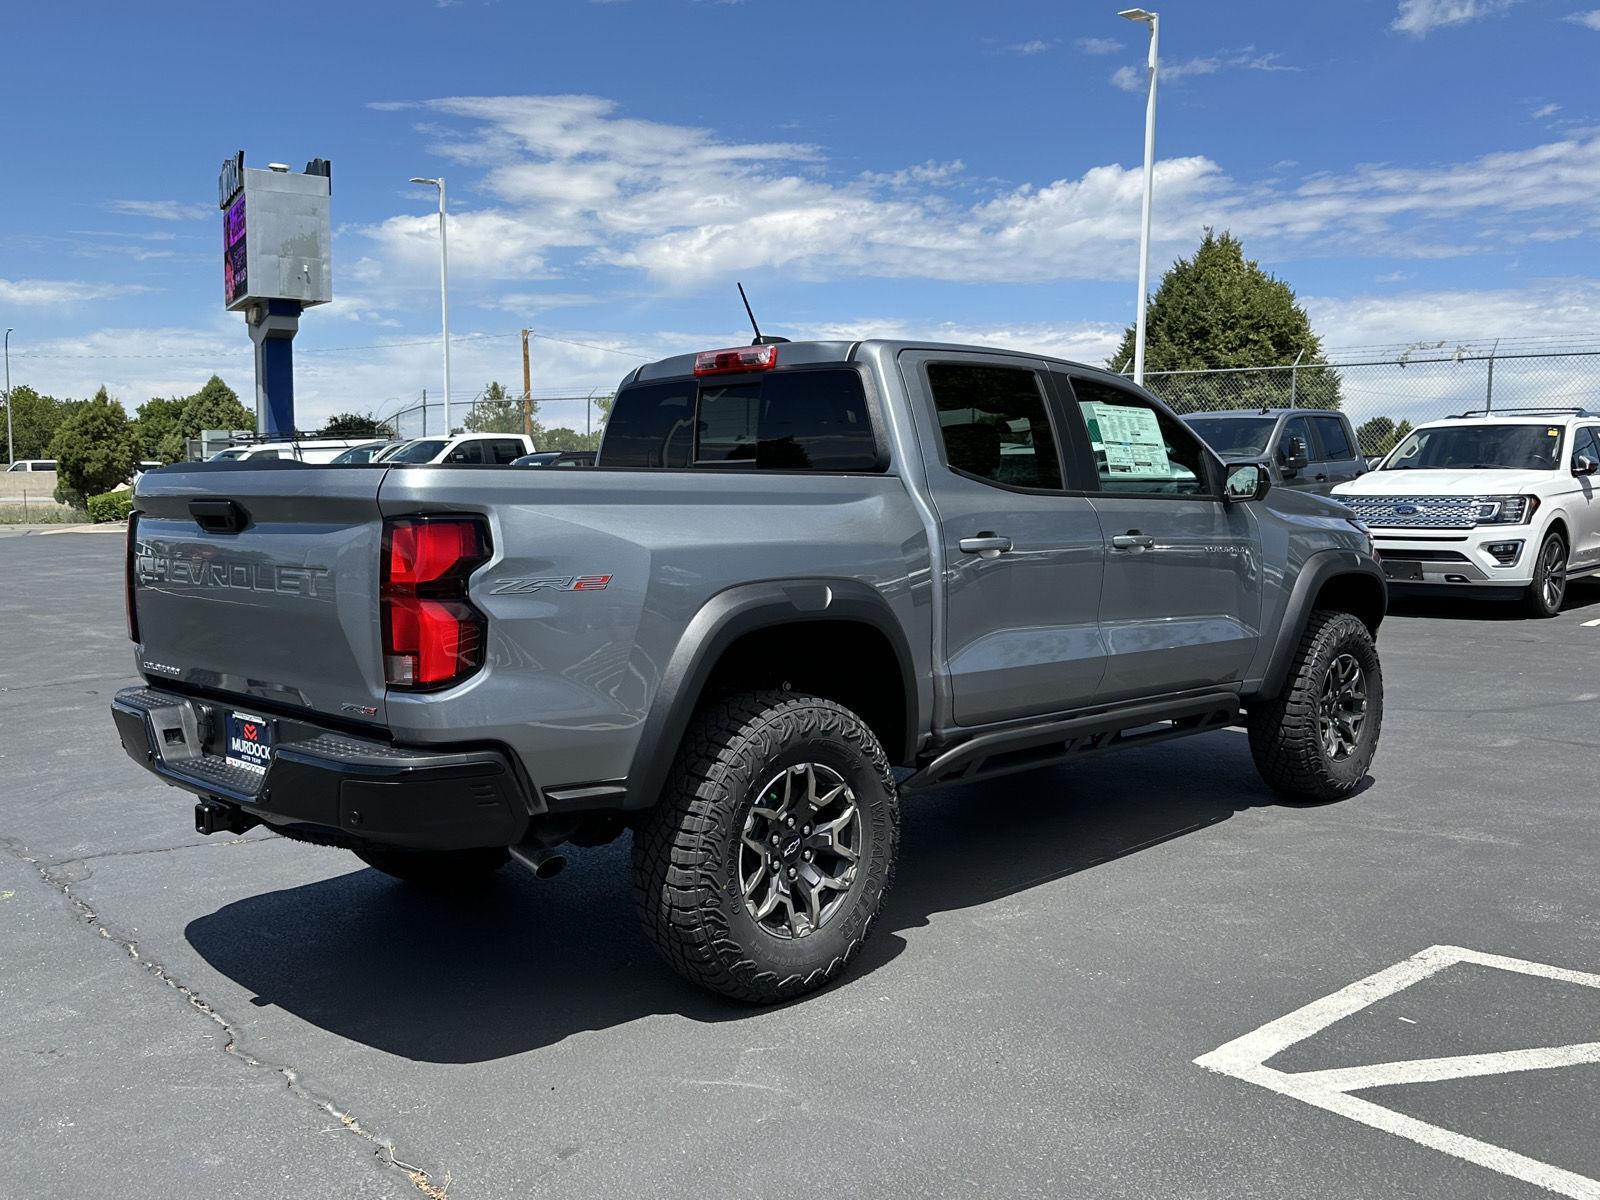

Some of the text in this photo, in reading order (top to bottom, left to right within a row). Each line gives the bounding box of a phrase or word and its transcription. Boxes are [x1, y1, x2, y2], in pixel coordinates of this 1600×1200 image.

[139, 555, 330, 596] CHEVROLET
[489, 573, 613, 595] ZR2
[232, 737, 271, 760] MURDOCK
